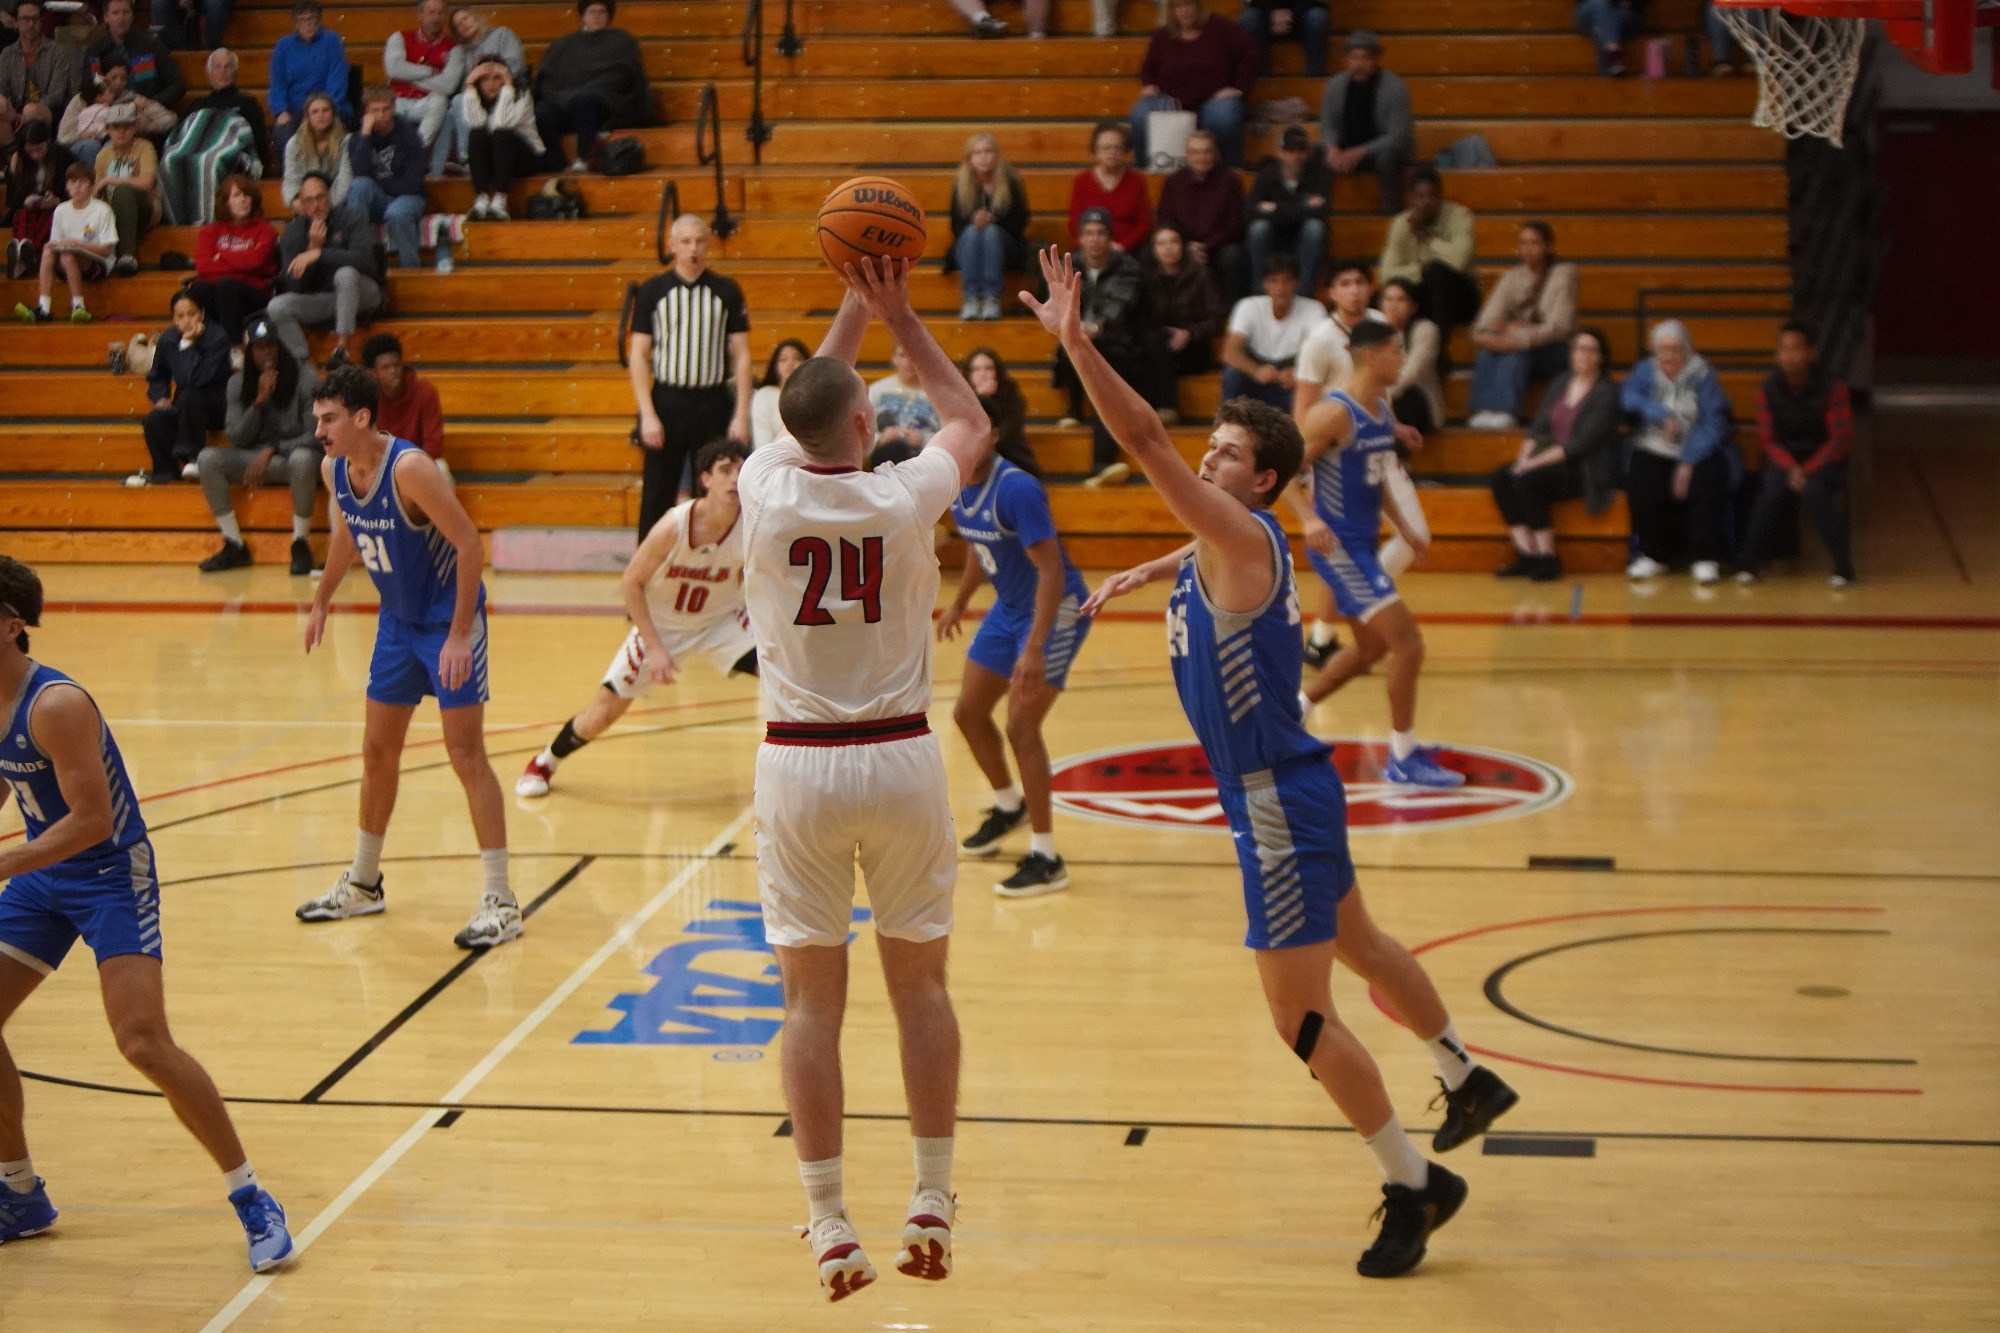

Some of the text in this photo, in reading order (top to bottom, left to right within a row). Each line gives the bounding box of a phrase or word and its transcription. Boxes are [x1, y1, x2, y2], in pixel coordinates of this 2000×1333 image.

[853, 187, 921, 222] Wilson
[861, 225, 907, 248] EVO
[356, 533, 394, 574] 21
[789, 535, 884, 627] 24
[674, 582, 711, 613] 10
[921, 1194, 945, 1208] INDIANA
[820, 1223, 845, 1239] INDIANA
